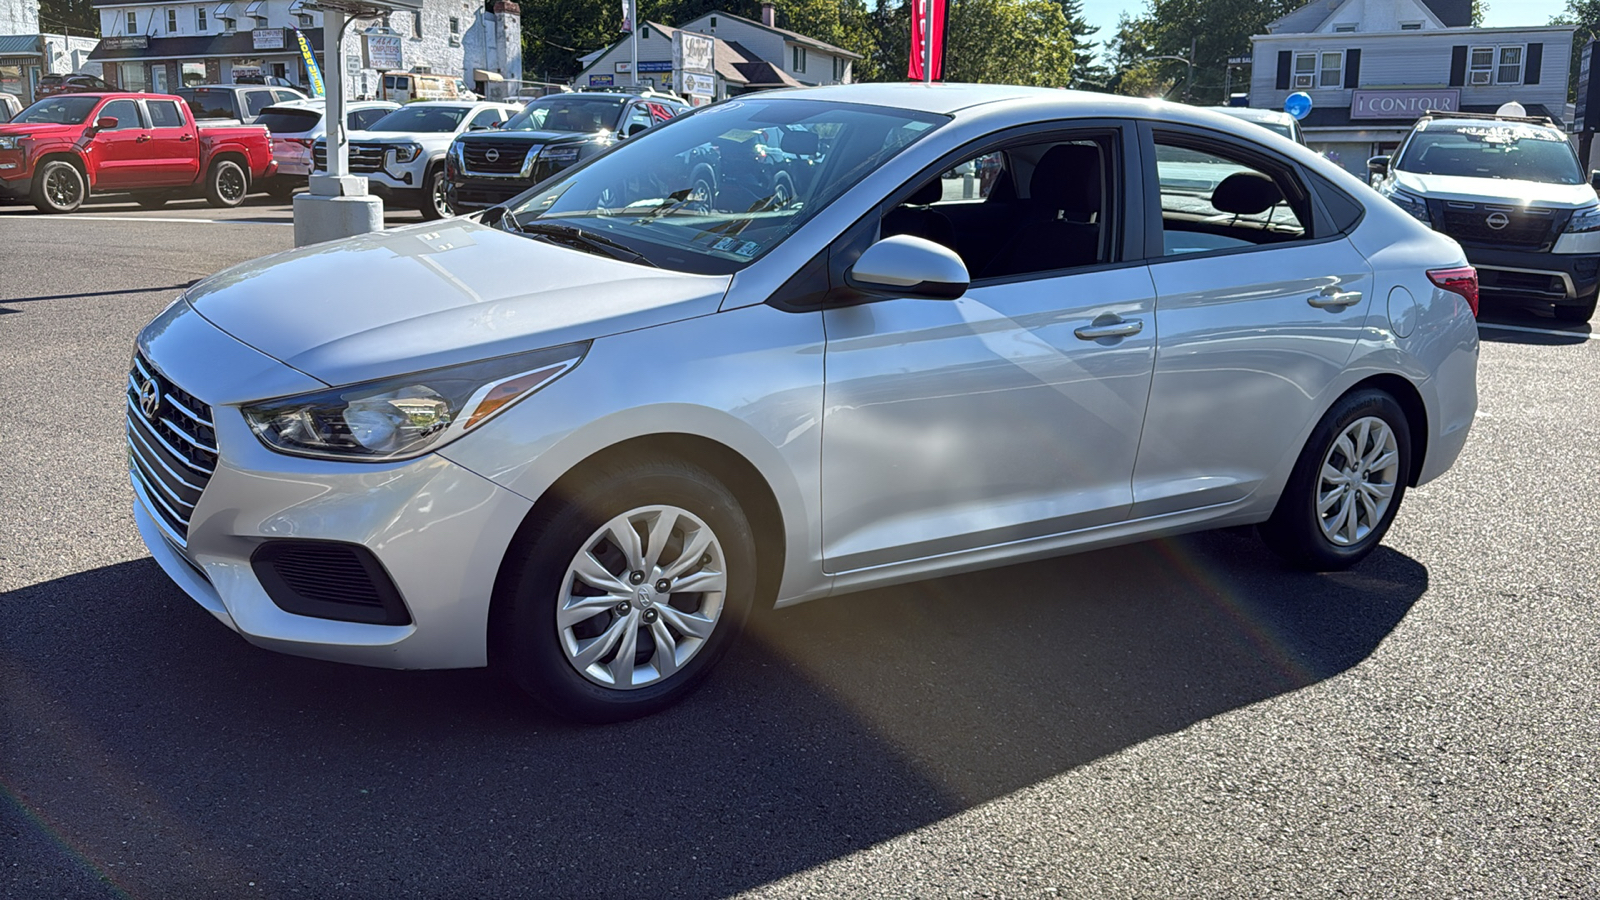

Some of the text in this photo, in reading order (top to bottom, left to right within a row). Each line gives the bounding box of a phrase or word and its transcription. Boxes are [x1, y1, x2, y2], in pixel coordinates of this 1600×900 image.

[370, 45, 399, 54] COMPUTERS
[298, 37, 323, 94] COMPUTER
[232, 69, 261, 78] COMPUTERS
[1368, 97, 1451, 112] CONTOUR
